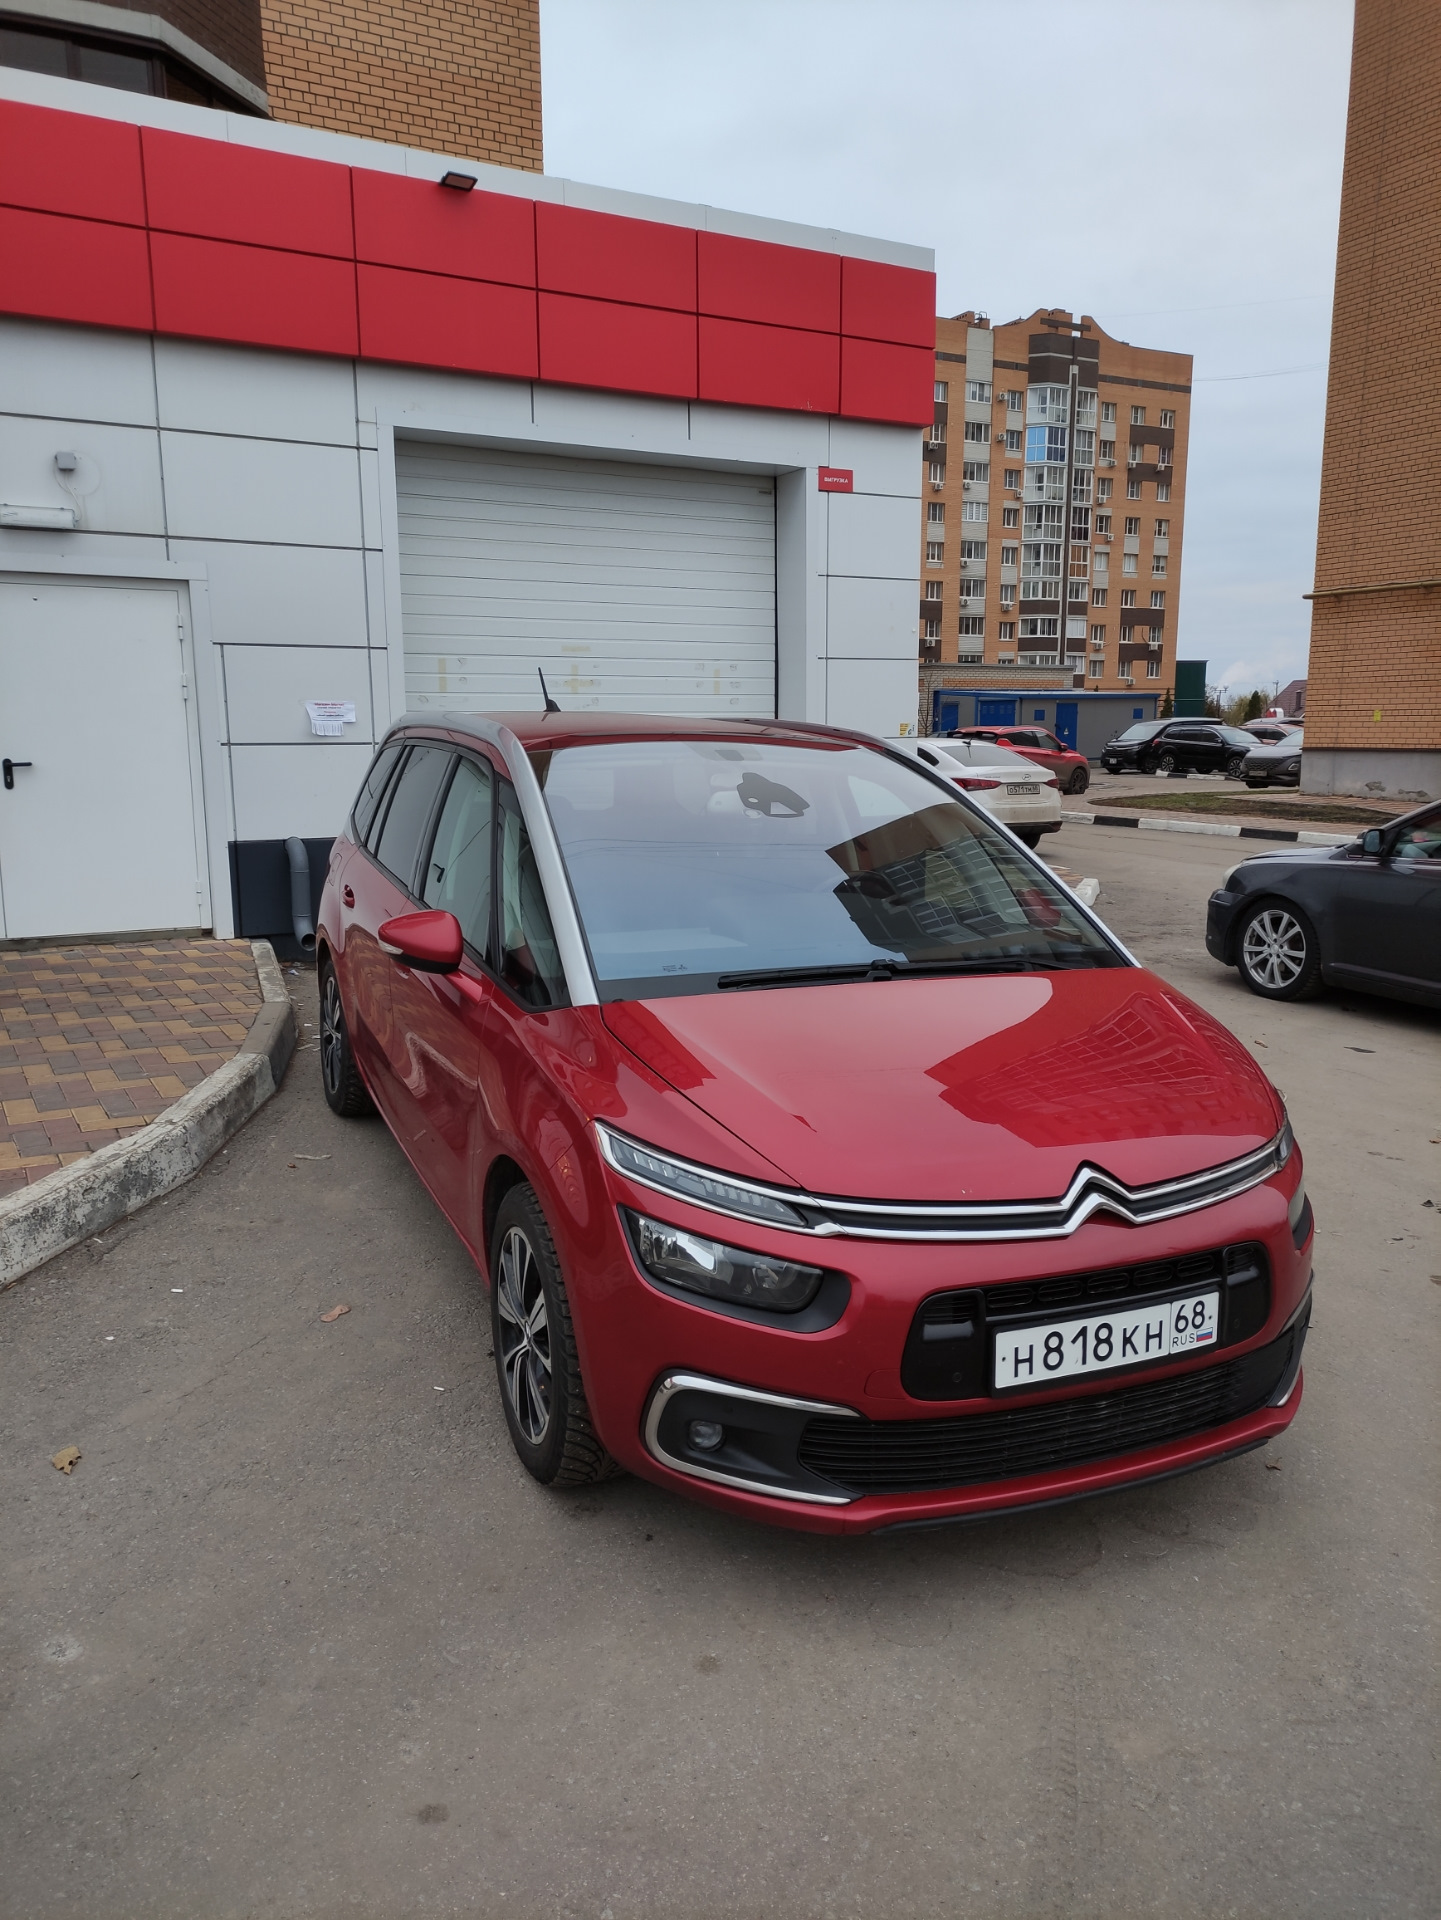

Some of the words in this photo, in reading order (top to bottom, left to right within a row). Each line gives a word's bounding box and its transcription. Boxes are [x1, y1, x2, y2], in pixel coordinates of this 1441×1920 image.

[1014, 1320, 1163, 1377] Н818КН
[1174, 1300, 1206, 1333] 68
[1172, 1332, 1195, 1348] RUS
